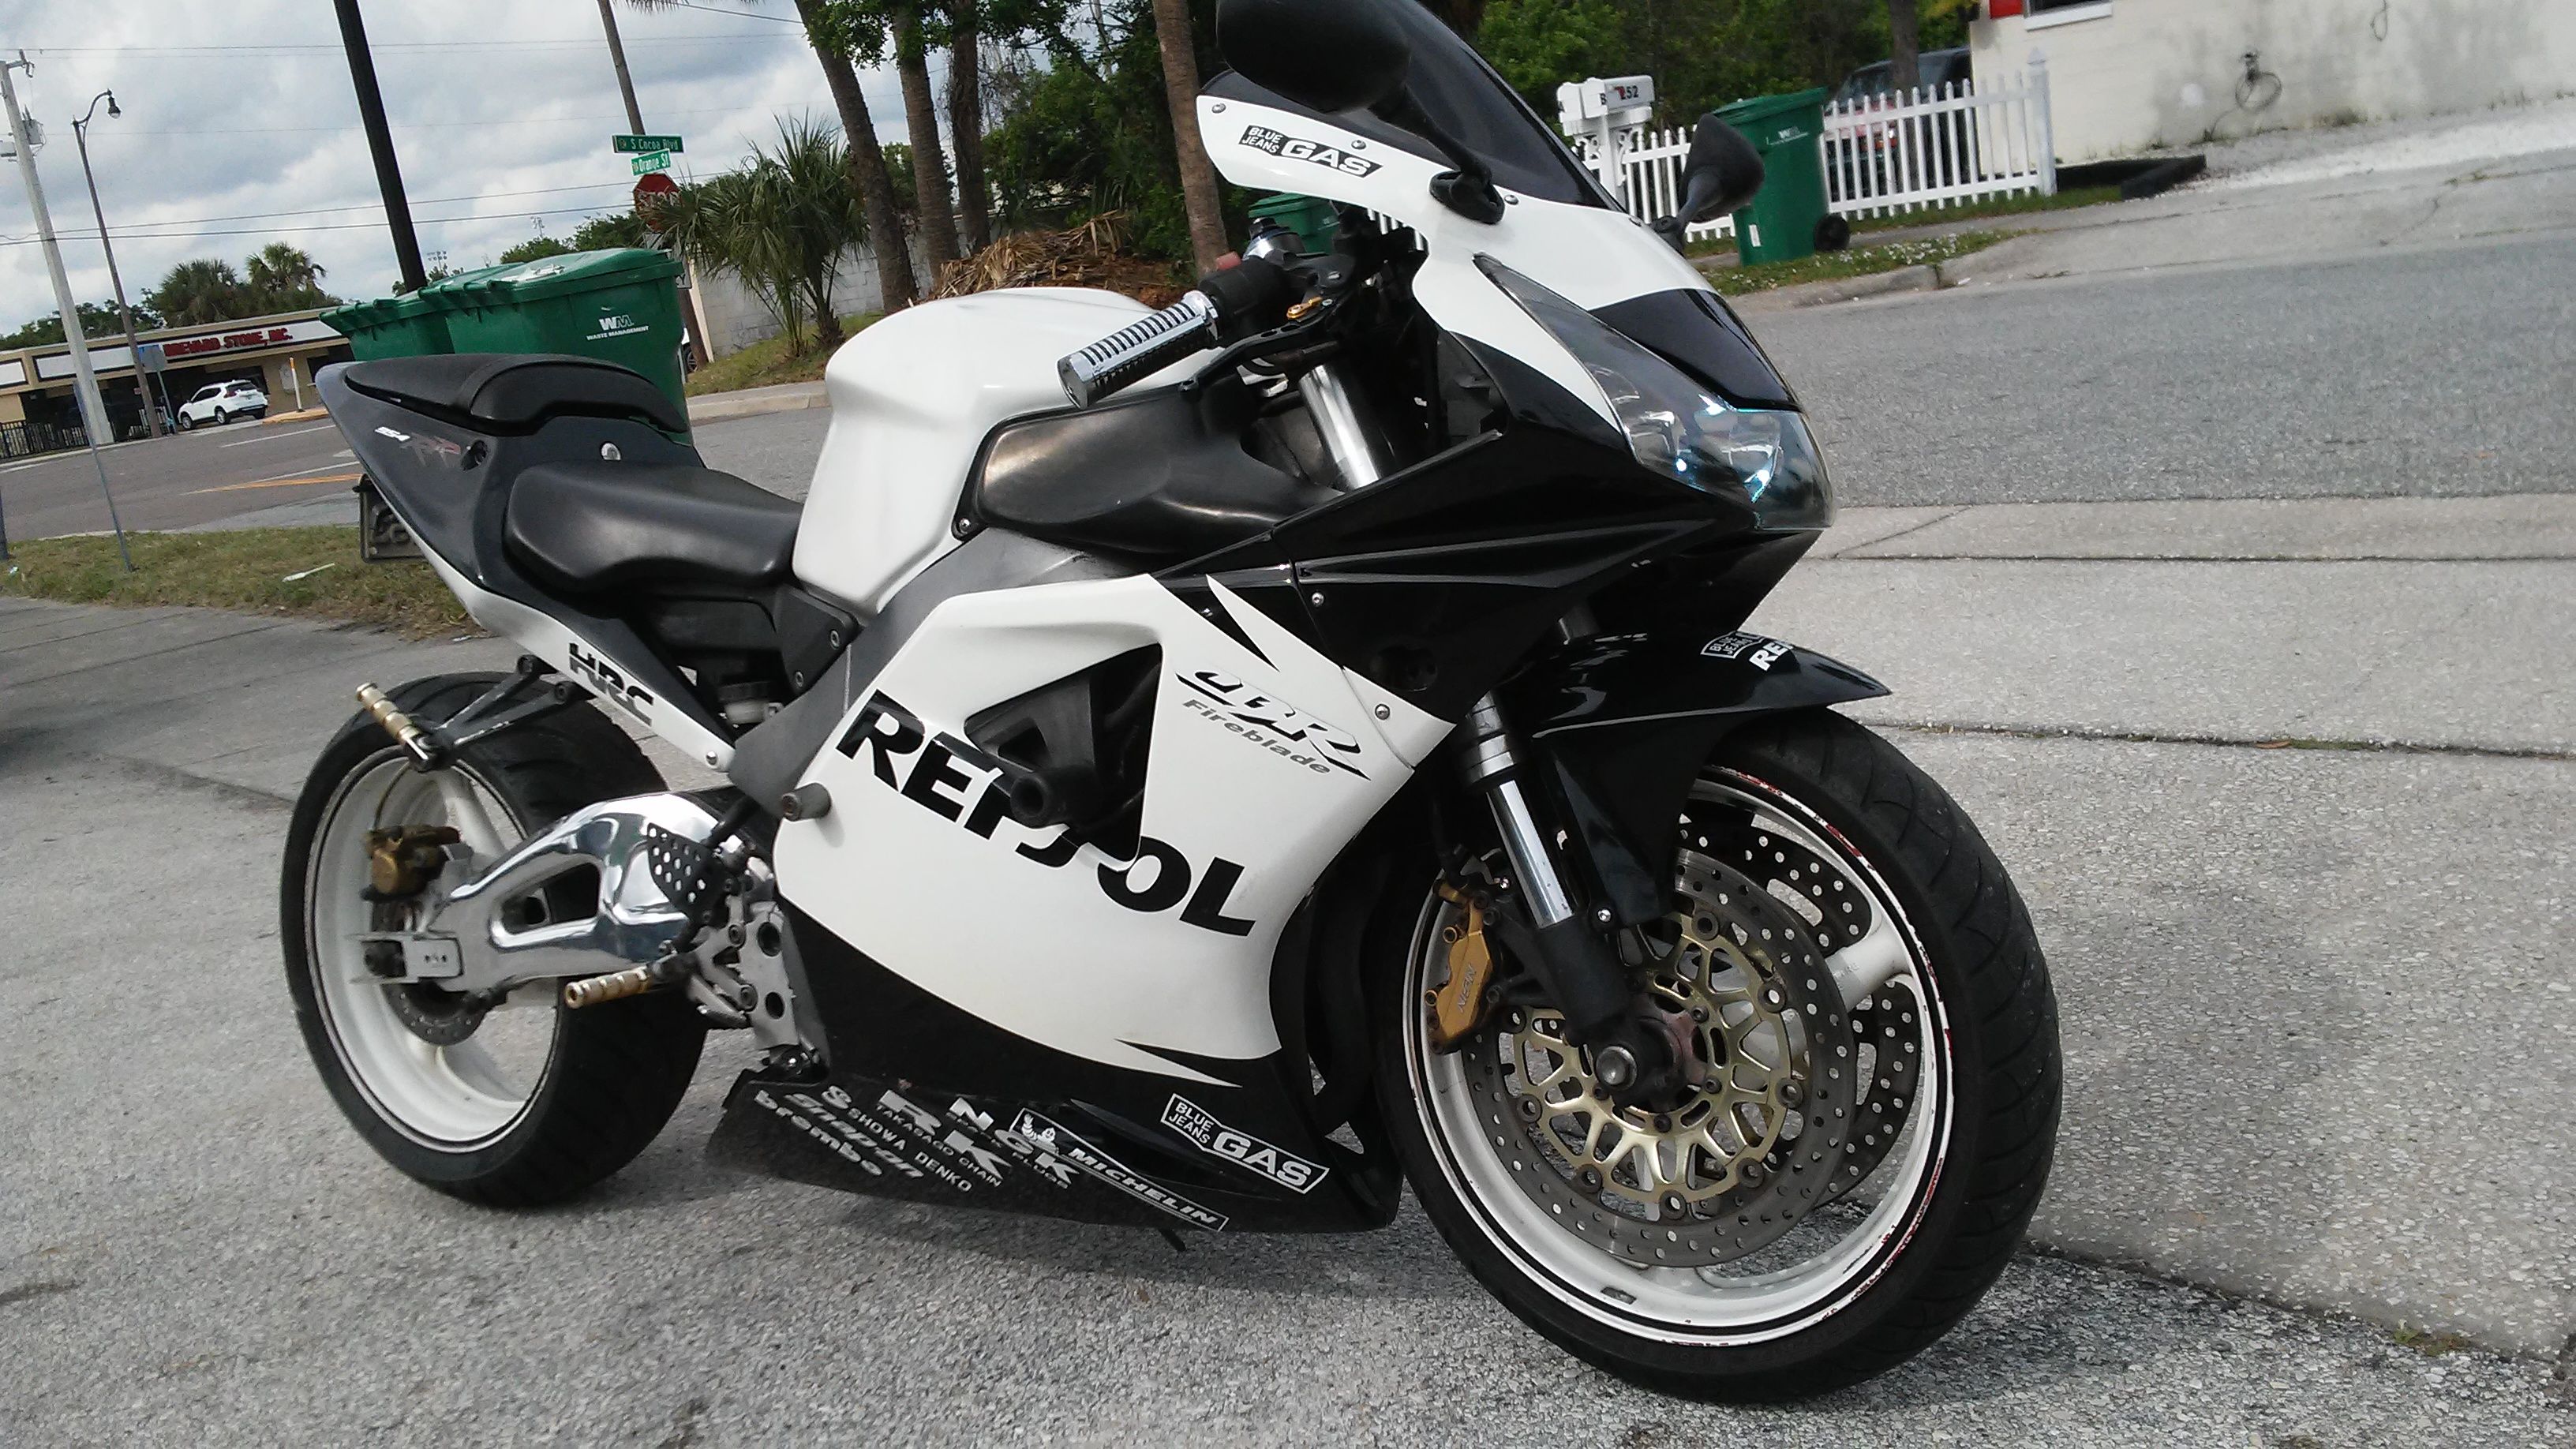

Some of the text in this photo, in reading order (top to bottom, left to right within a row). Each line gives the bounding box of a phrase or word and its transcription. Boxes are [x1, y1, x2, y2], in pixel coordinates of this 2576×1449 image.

[638, 138, 661, 150] Cocoa
[662, 139, 679, 150] Blvd
[1241, 136, 1280, 154] JEANS
[1249, 127, 1283, 144] BLUE
[638, 152, 669, 172] Orange St
[1281, 140, 1371, 175] GAS
[598, 314, 635, 331] WM
[608, 325, 650, 337] MANAGEMENT
[569, 642, 654, 727] HRC
[1182, 698, 1331, 774] Fireblade
[754, 1089, 883, 1176] brembo
[1168, 1113, 1211, 1145] JEANS
[1174, 1101, 1214, 1133] BLUE
[847, 1106, 907, 1151] SHOWA
[914, 1151, 972, 1193] DENKO
[876, 1104, 1002, 1188] TAKASAGO CHAIN
[1212, 1131, 1312, 1186] GAS
[1068, 1148, 1219, 1224] MICHELIN
